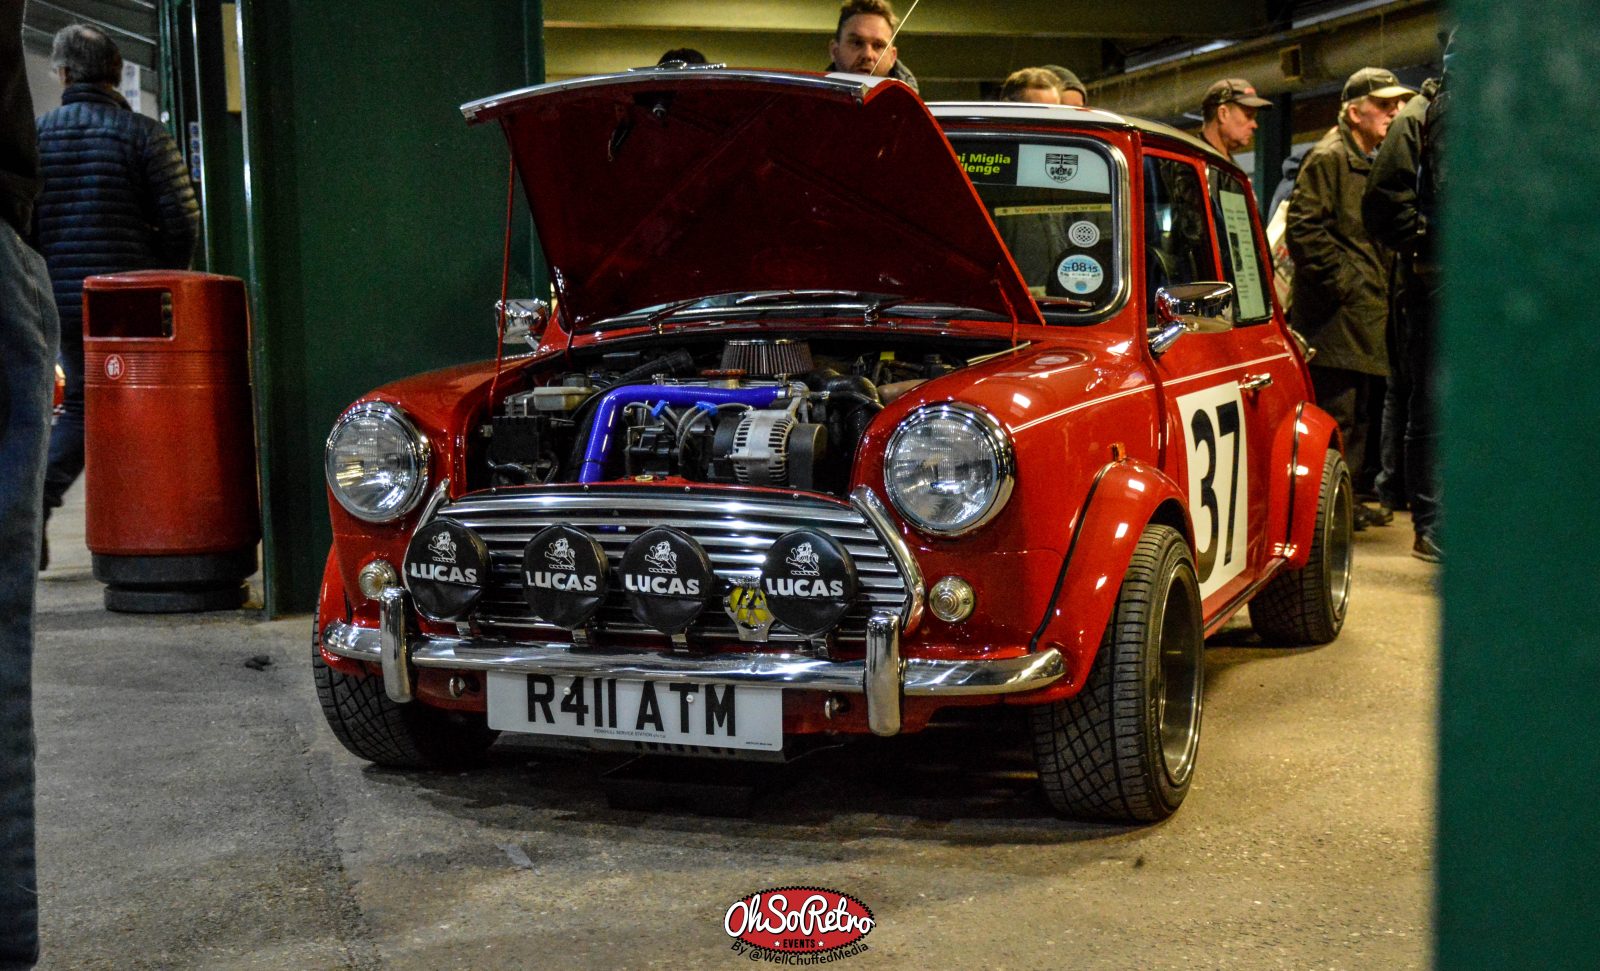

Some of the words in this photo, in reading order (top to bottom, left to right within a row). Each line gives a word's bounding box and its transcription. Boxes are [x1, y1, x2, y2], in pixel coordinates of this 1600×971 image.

[970, 153, 1011, 166] Miglia
[1071, 262, 1087, 272] 08
[1191, 400, 1240, 584] 37
[410, 562, 477, 584] LUCAS
[526, 570, 597, 592] LUCAS
[625, 574, 700, 596] LUCAS
[766, 577, 844, 597] LUCAS
[527, 673, 618, 729] R411
[635, 680, 736, 737] ATM
